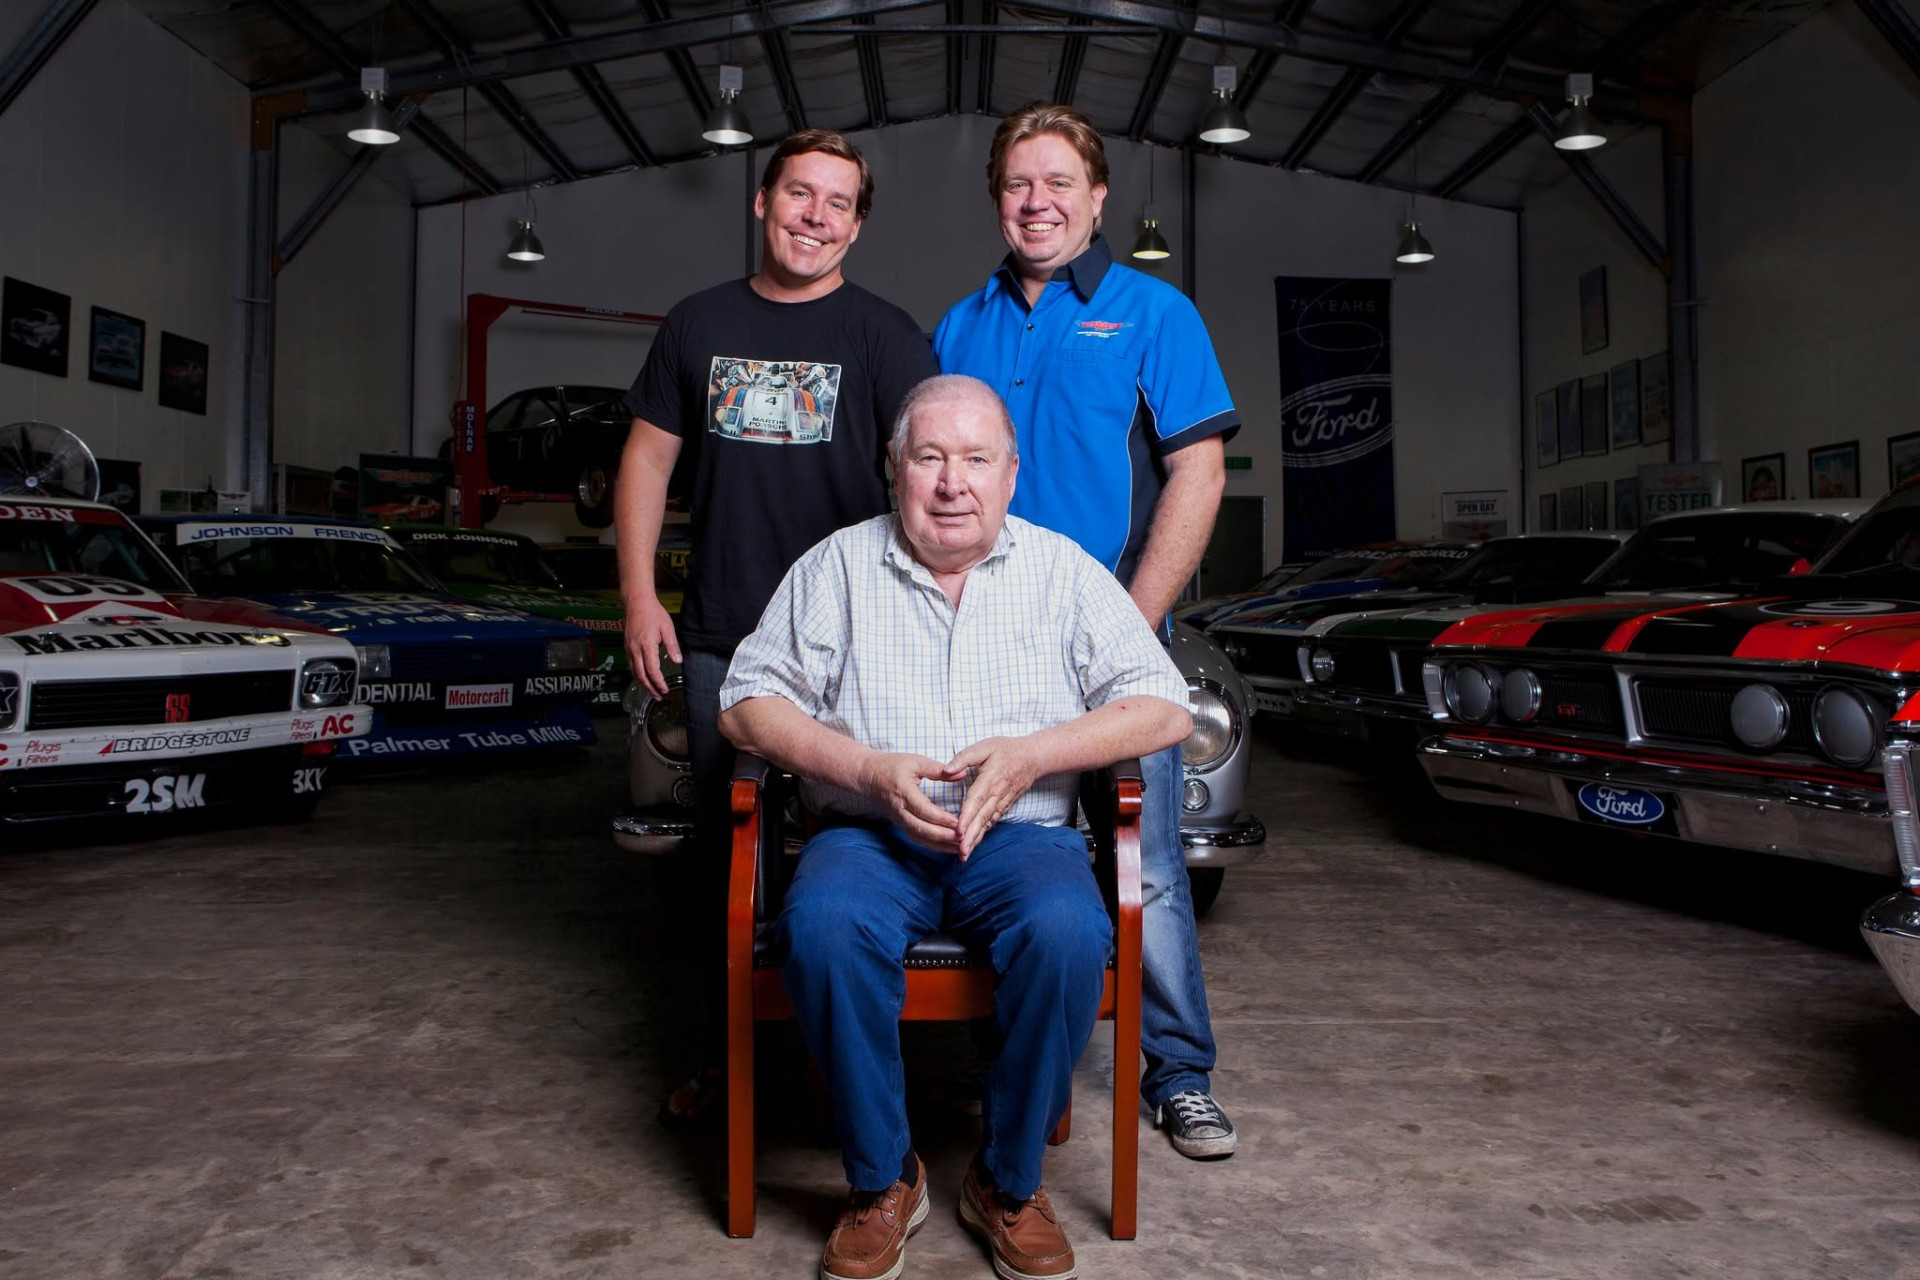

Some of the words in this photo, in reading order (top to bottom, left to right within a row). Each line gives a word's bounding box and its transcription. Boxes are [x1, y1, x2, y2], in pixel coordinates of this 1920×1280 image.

[1317, 299, 1377, 312] YEARS
[765, 397, 777, 405] 4
[752, 417, 787, 425] MARTINI
[1292, 393, 1380, 447] Ford
[1458, 503, 1477, 512] OPEN
[1480, 503, 1495, 512] DAY
[1645, 493, 1712, 511] TESTED
[192, 526, 294, 540] JOHNSON
[314, 527, 388, 544] FRENCH
[452, 534, 519, 547] JOHNSON
[19, 577, 145, 596] 05
[303, 670, 356, 695] GTX
[525, 674, 607, 696] ASSURANCE
[449, 687, 510, 706] Motorcraft
[291, 719, 315, 732] Plugs
[321, 714, 354, 737] AC
[113, 728, 251, 753] BRIDGESTONE
[290, 731, 313, 741] Filters
[349, 736, 452, 756] Palmer
[458, 732, 527, 750] Tube
[528, 726, 582, 743] Mills
[25, 740, 61, 755] Plugs
[26, 754, 59, 765] Filters
[292, 767, 328, 794] 3KY
[124, 773, 207, 814] 2SM
[1596, 786, 1647, 817] Ford
